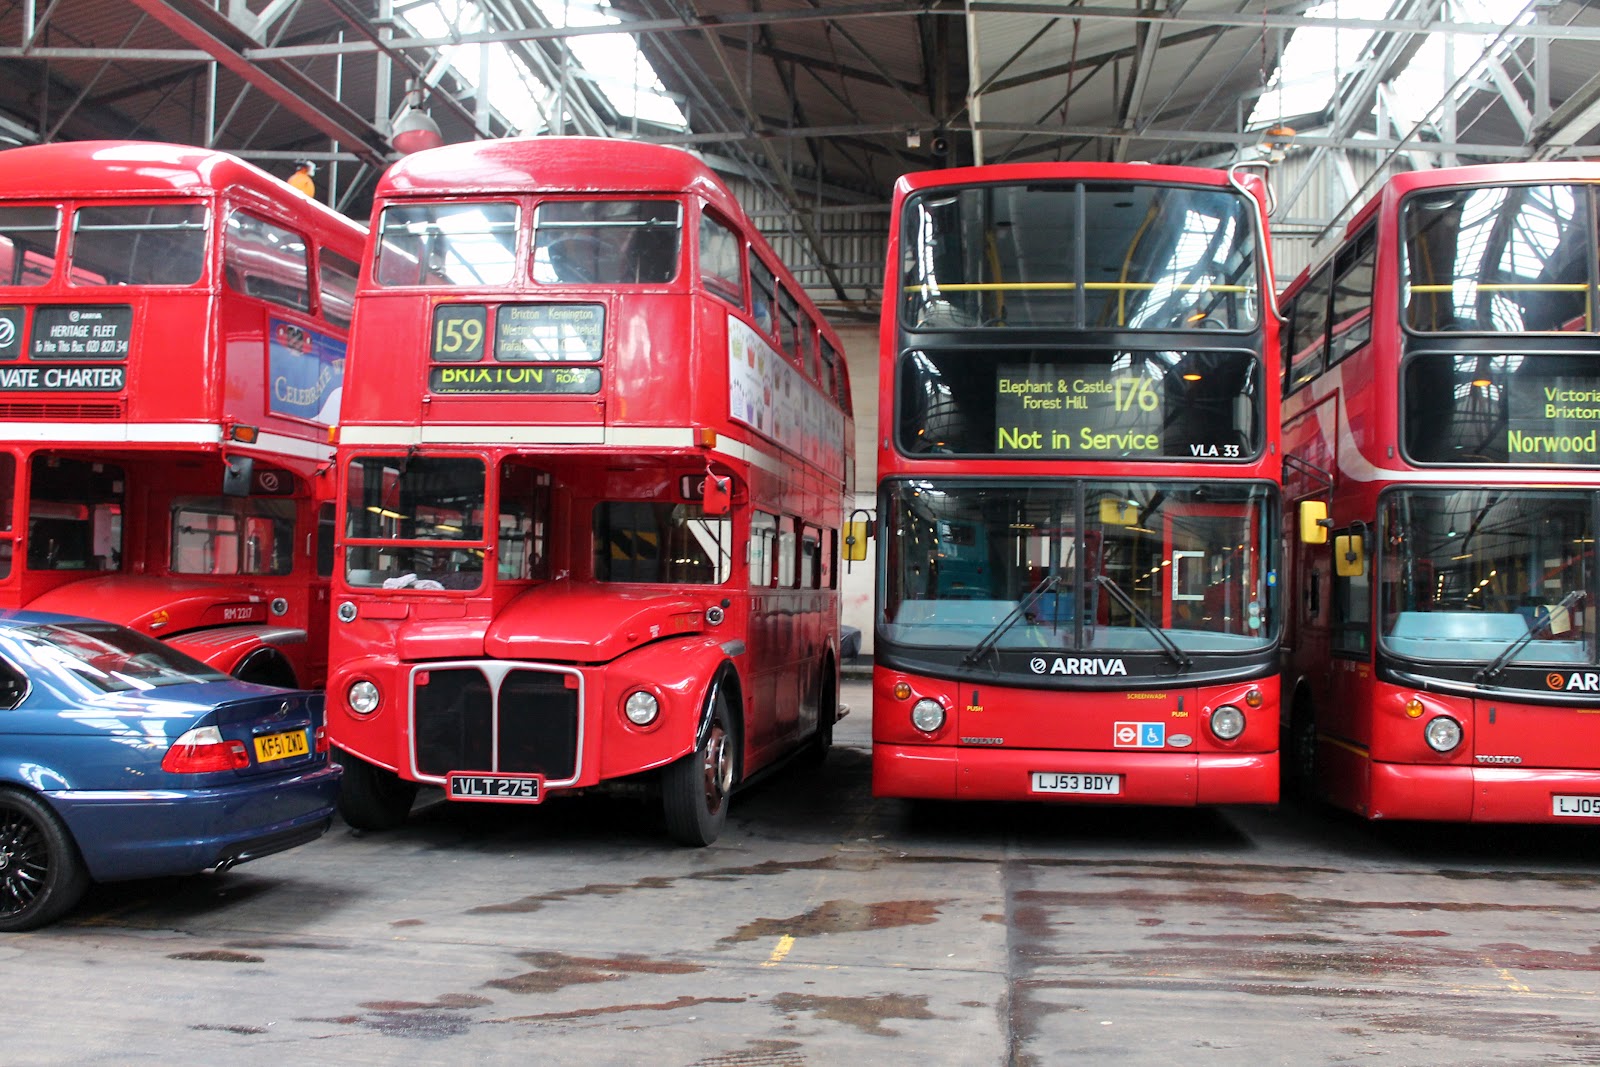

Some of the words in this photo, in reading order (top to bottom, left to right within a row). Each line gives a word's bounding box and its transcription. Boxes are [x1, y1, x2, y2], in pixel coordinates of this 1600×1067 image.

[511, 308, 539, 320] Brixton
[548, 307, 593, 322] Kennington
[50, 325, 90, 337] HERITAGE
[92, 325, 117, 337] FLEET
[436, 319, 483, 353] 159
[44, 368, 123, 387] CHARTER
[999, 379, 1053, 396] Elephant
[1057, 380, 1069, 393] &
[1073, 379, 1113, 393] Castle
[1114, 377, 1159, 412] 176
[1023, 396, 1062, 409] Forest
[1066, 396, 1088, 409] Hill
[998, 427, 1042, 450] Not
[1052, 429, 1071, 449] in
[1080, 427, 1159, 450] Service
[1508, 430, 1597, 453] Norwood
[1190, 444, 1219, 457] VLA
[1223, 444, 1239, 457] 33
[223, 608, 237, 619] RM
[1050, 657, 1127, 676] ARRIVA
[261, 737, 285, 757] KF51
[285, 733, 303, 753] ZWD
[961, 737, 1004, 745] VOLVO
[1475, 755, 1522, 764] VOLVO
[460, 779, 494, 795] VLT
[498, 780, 532, 796] 275
[1038, 775, 1079, 790] LJ53
[1083, 775, 1113, 791] BDY
[1560, 798, 1600, 813] LJ05
